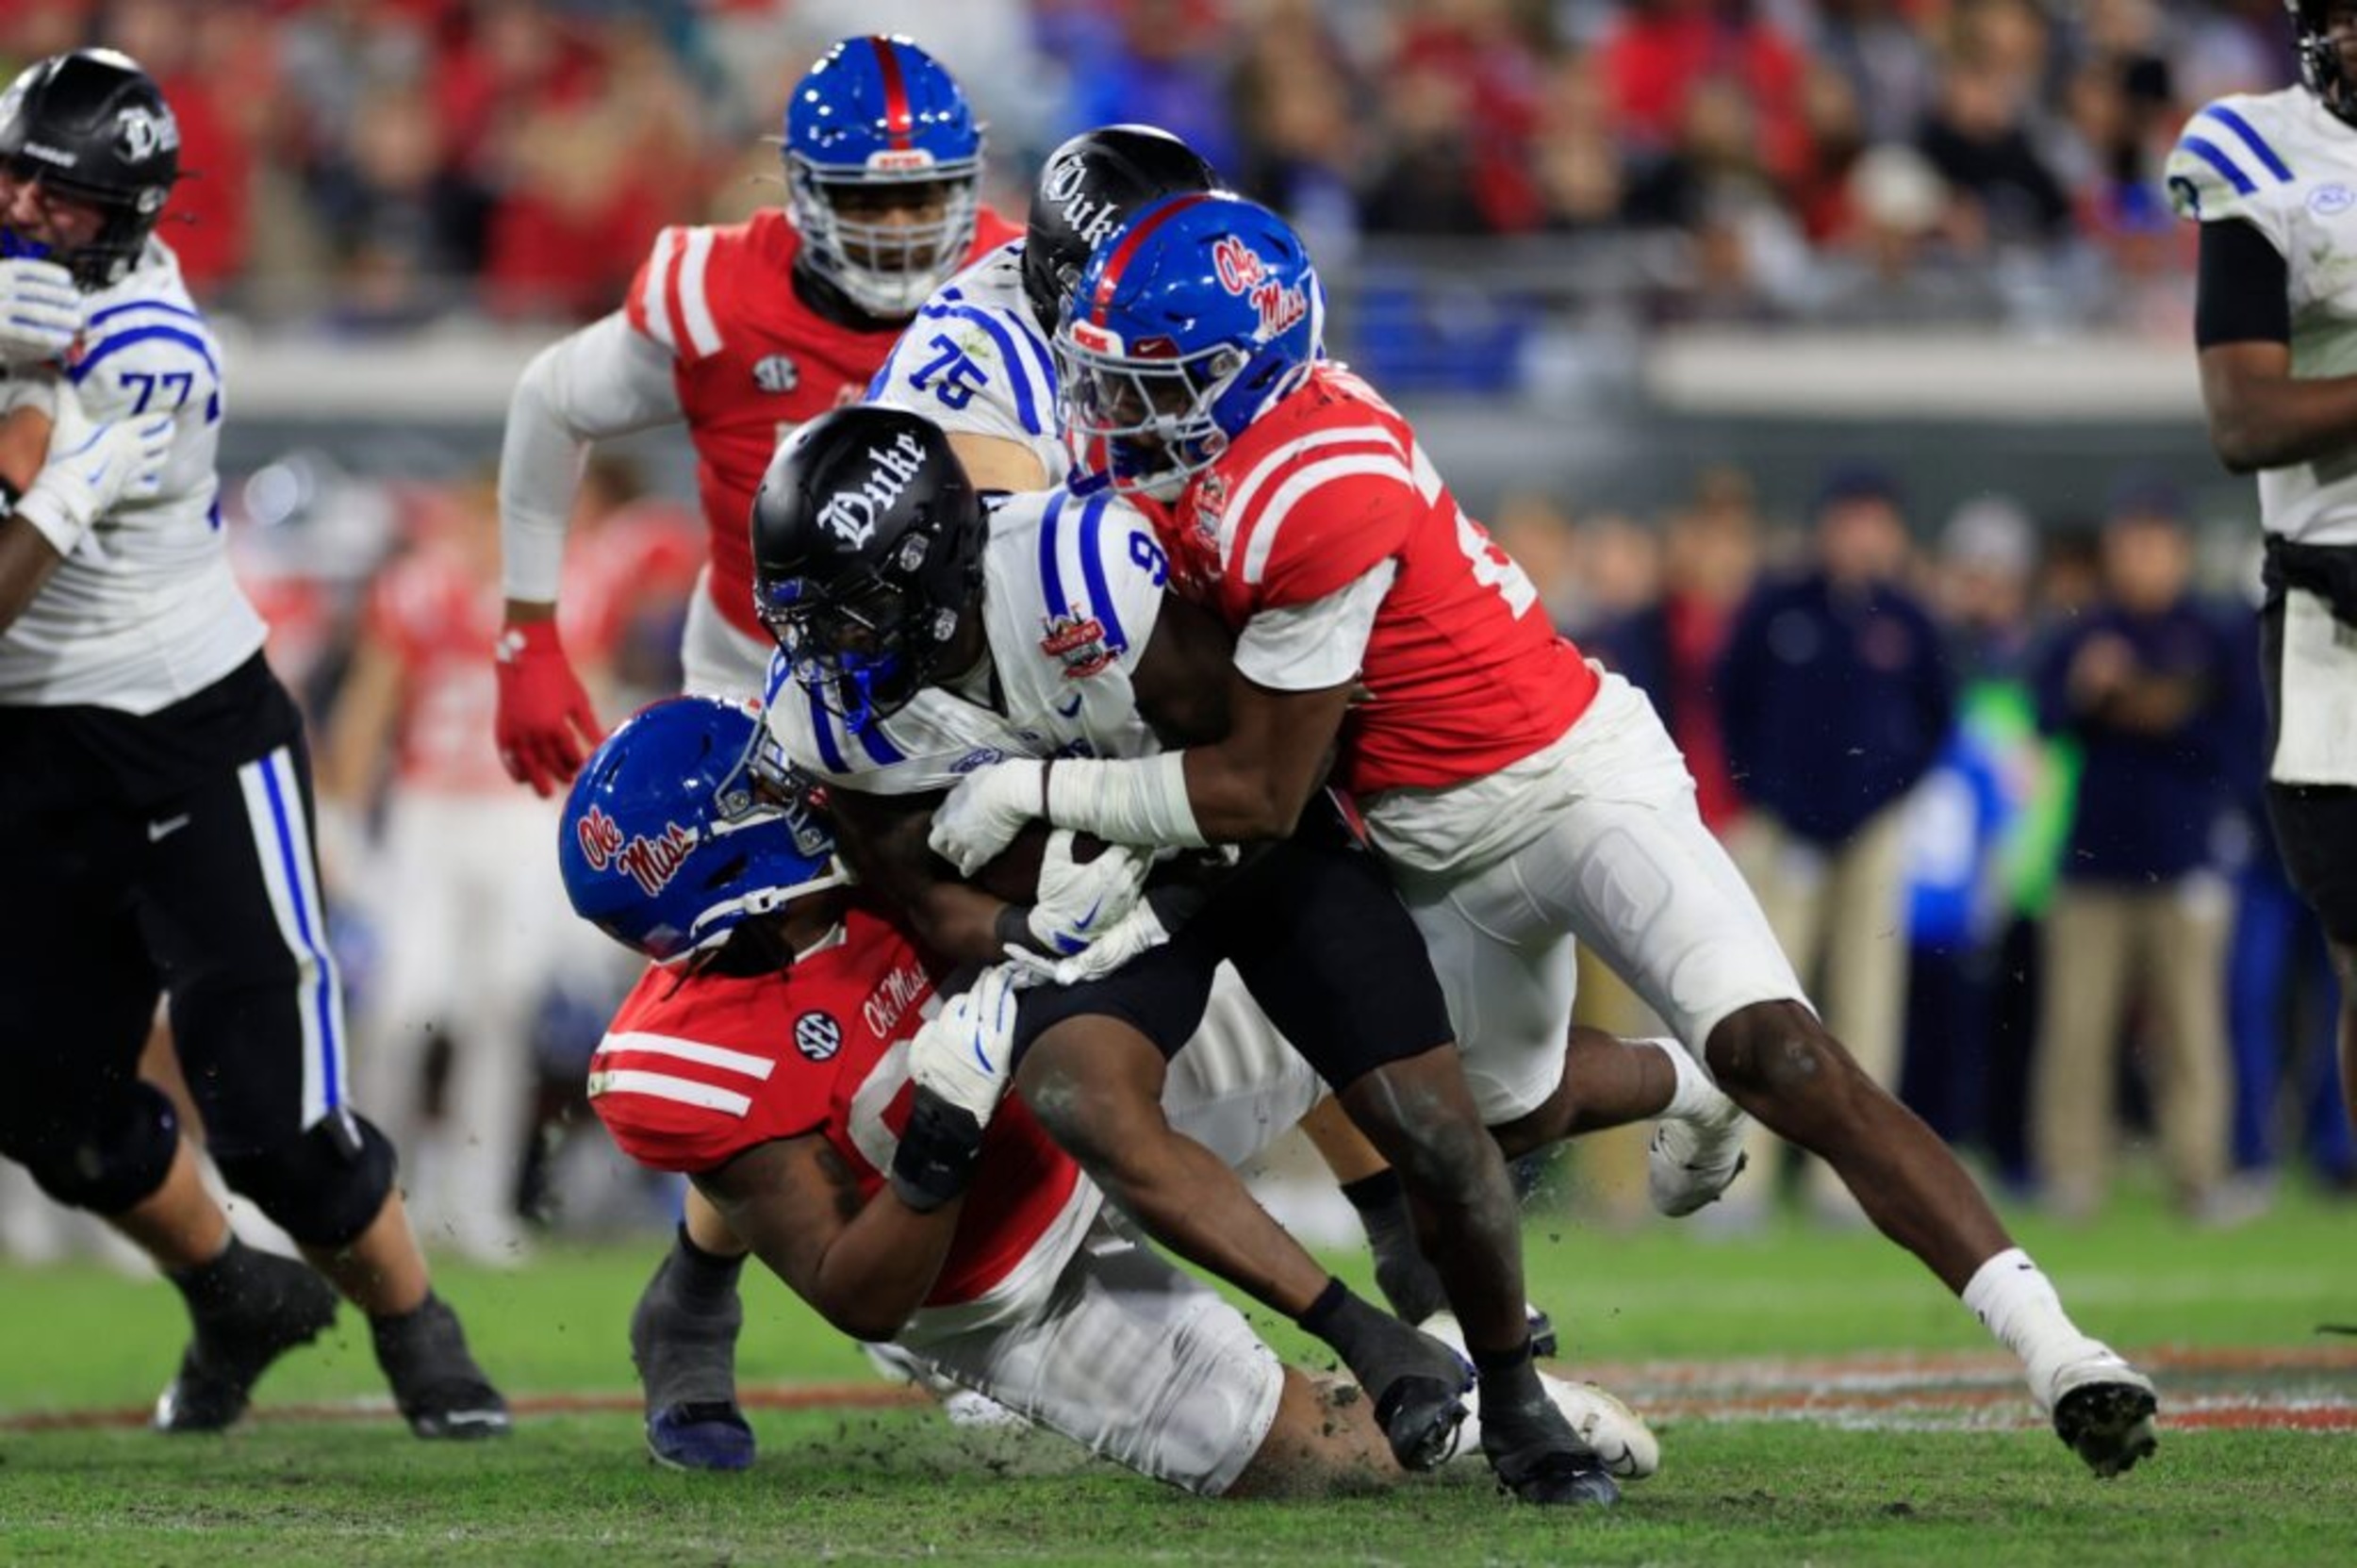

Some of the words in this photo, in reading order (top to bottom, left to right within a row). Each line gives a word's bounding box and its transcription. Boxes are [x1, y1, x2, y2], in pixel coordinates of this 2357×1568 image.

[1046, 151, 1119, 252] Duk
[1213, 235, 1266, 296] Ole
[1249, 279, 1307, 336] Miss
[119, 372, 193, 417] 77
[908, 333, 989, 410] 75
[816, 430, 927, 550] Duke
[1129, 530, 1170, 587] 9
[577, 803, 624, 871] Ole
[616, 819, 699, 898] Miss
[794, 1012, 841, 1061] SEC
[864, 993, 898, 1039] Ole
